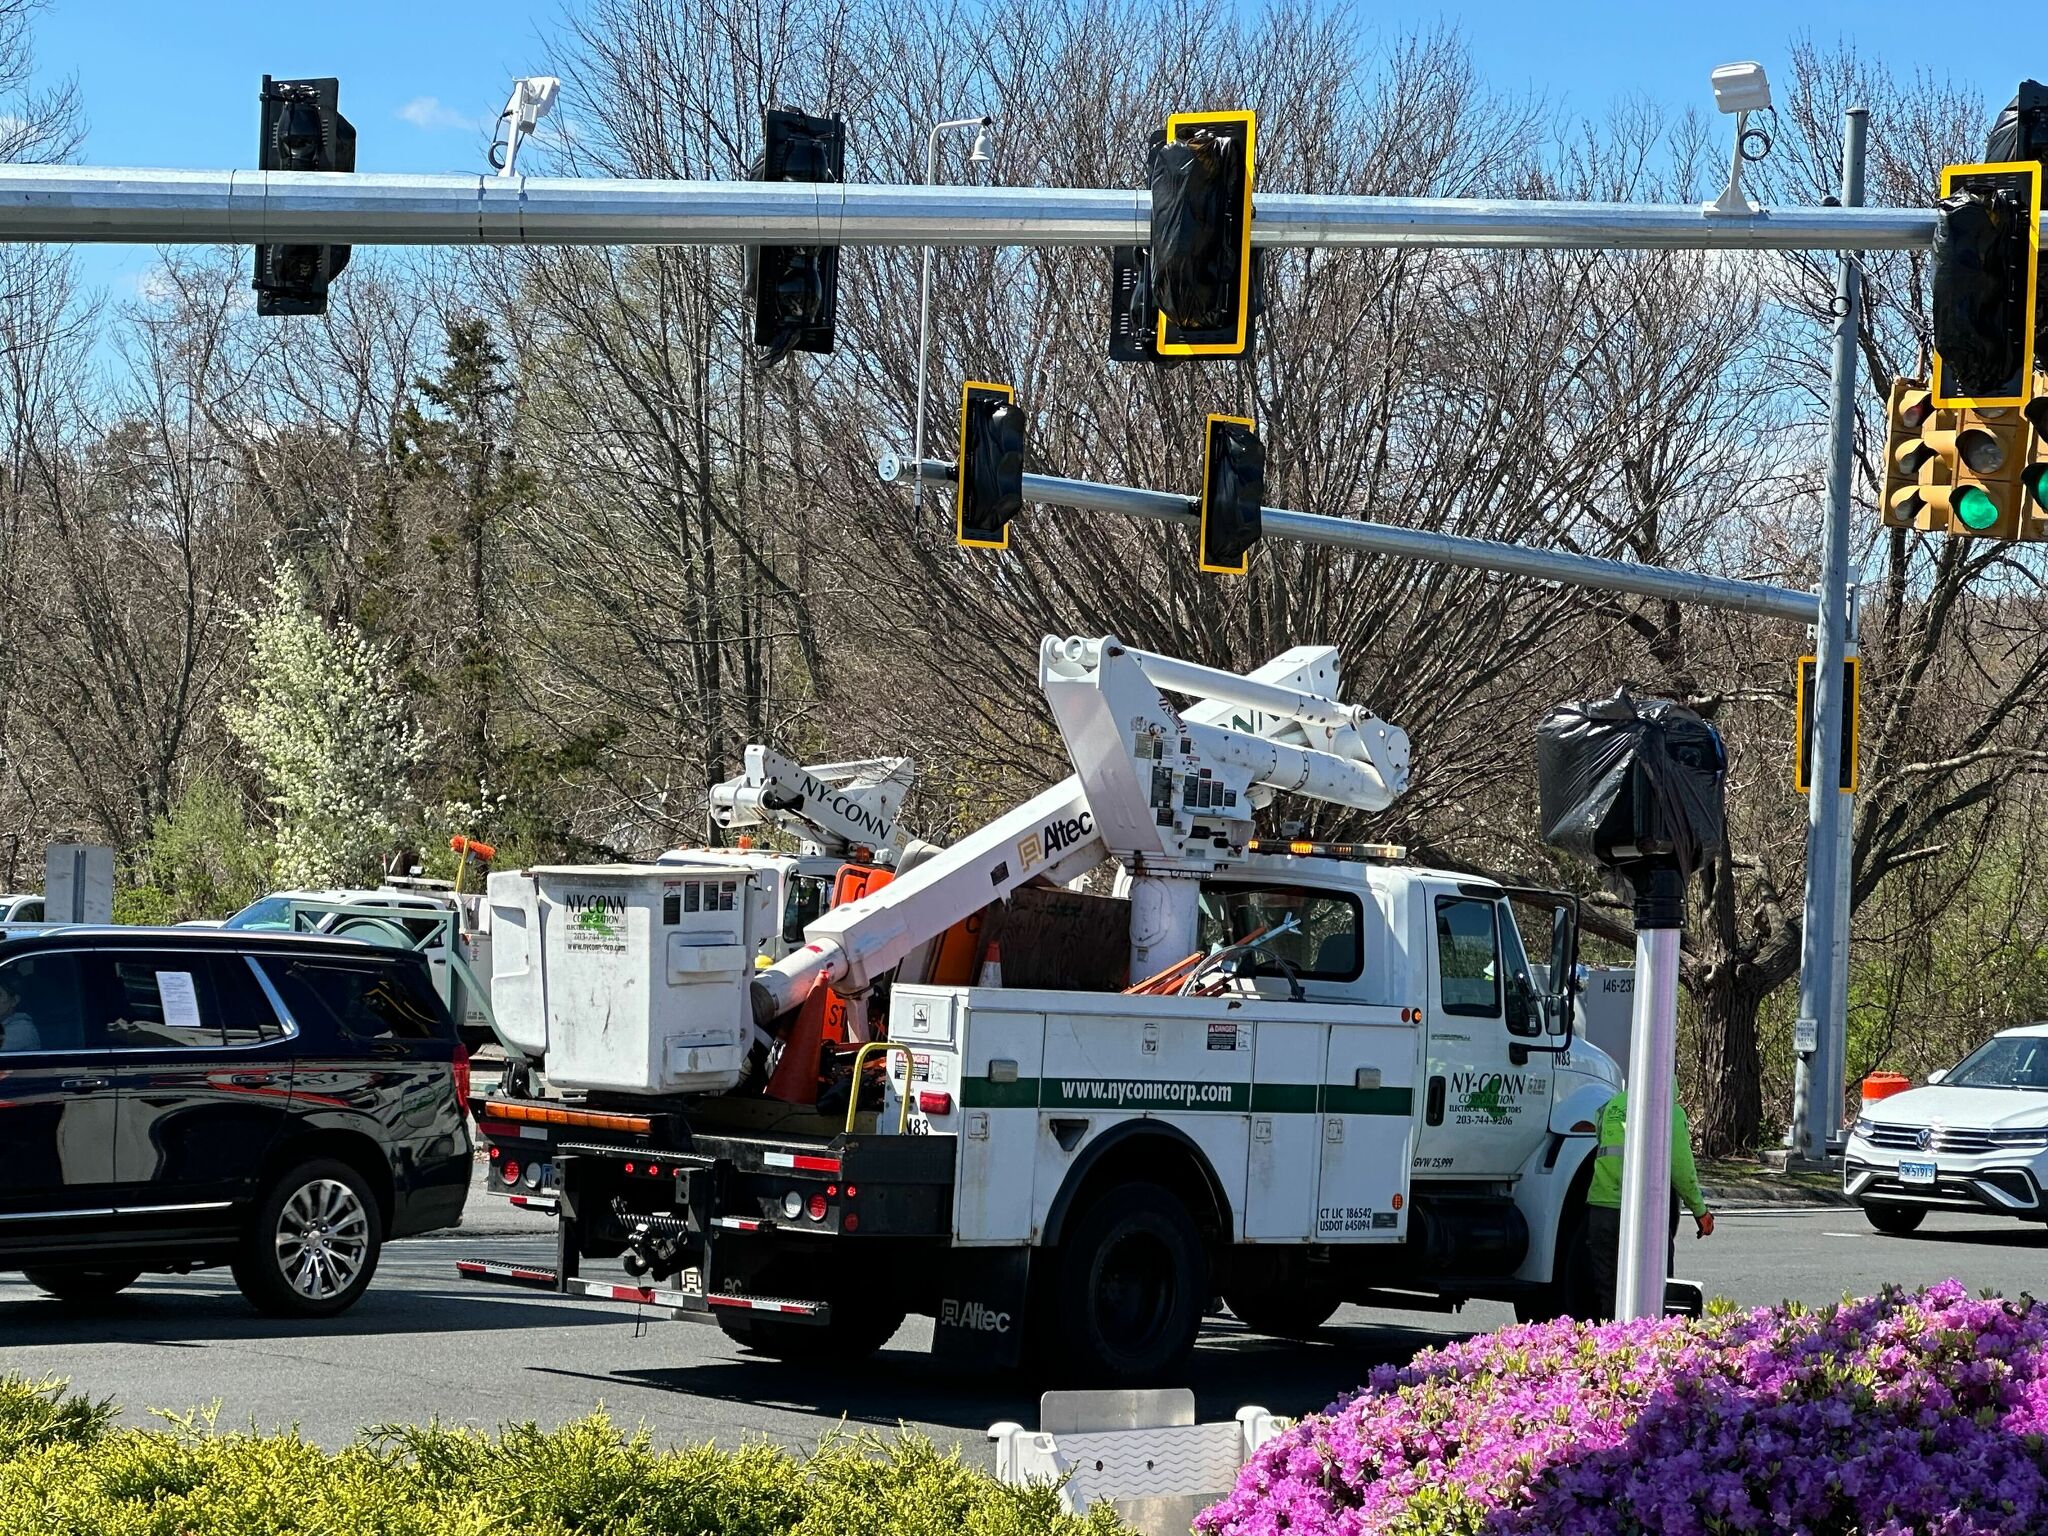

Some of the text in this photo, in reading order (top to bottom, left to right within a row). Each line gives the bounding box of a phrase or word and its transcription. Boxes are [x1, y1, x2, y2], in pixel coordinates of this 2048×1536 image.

[800, 776, 891, 840] NY-CONN
[1044, 811, 1093, 860] Altec
[1061, 1081, 1232, 1107] www.nyconncorp.com
[1450, 1072, 1526, 1095] NY-CONN
[1455, 1115, 1513, 1126] 203-744-9206
[1413, 1157, 1432, 1168] GVW
[1320, 1207, 1372, 1219] CT LIC 186542
[1319, 1220, 1343, 1231] USDOT
[1344, 1219, 1370, 1231] 645094
[959, 1301, 1011, 1333] Altec
